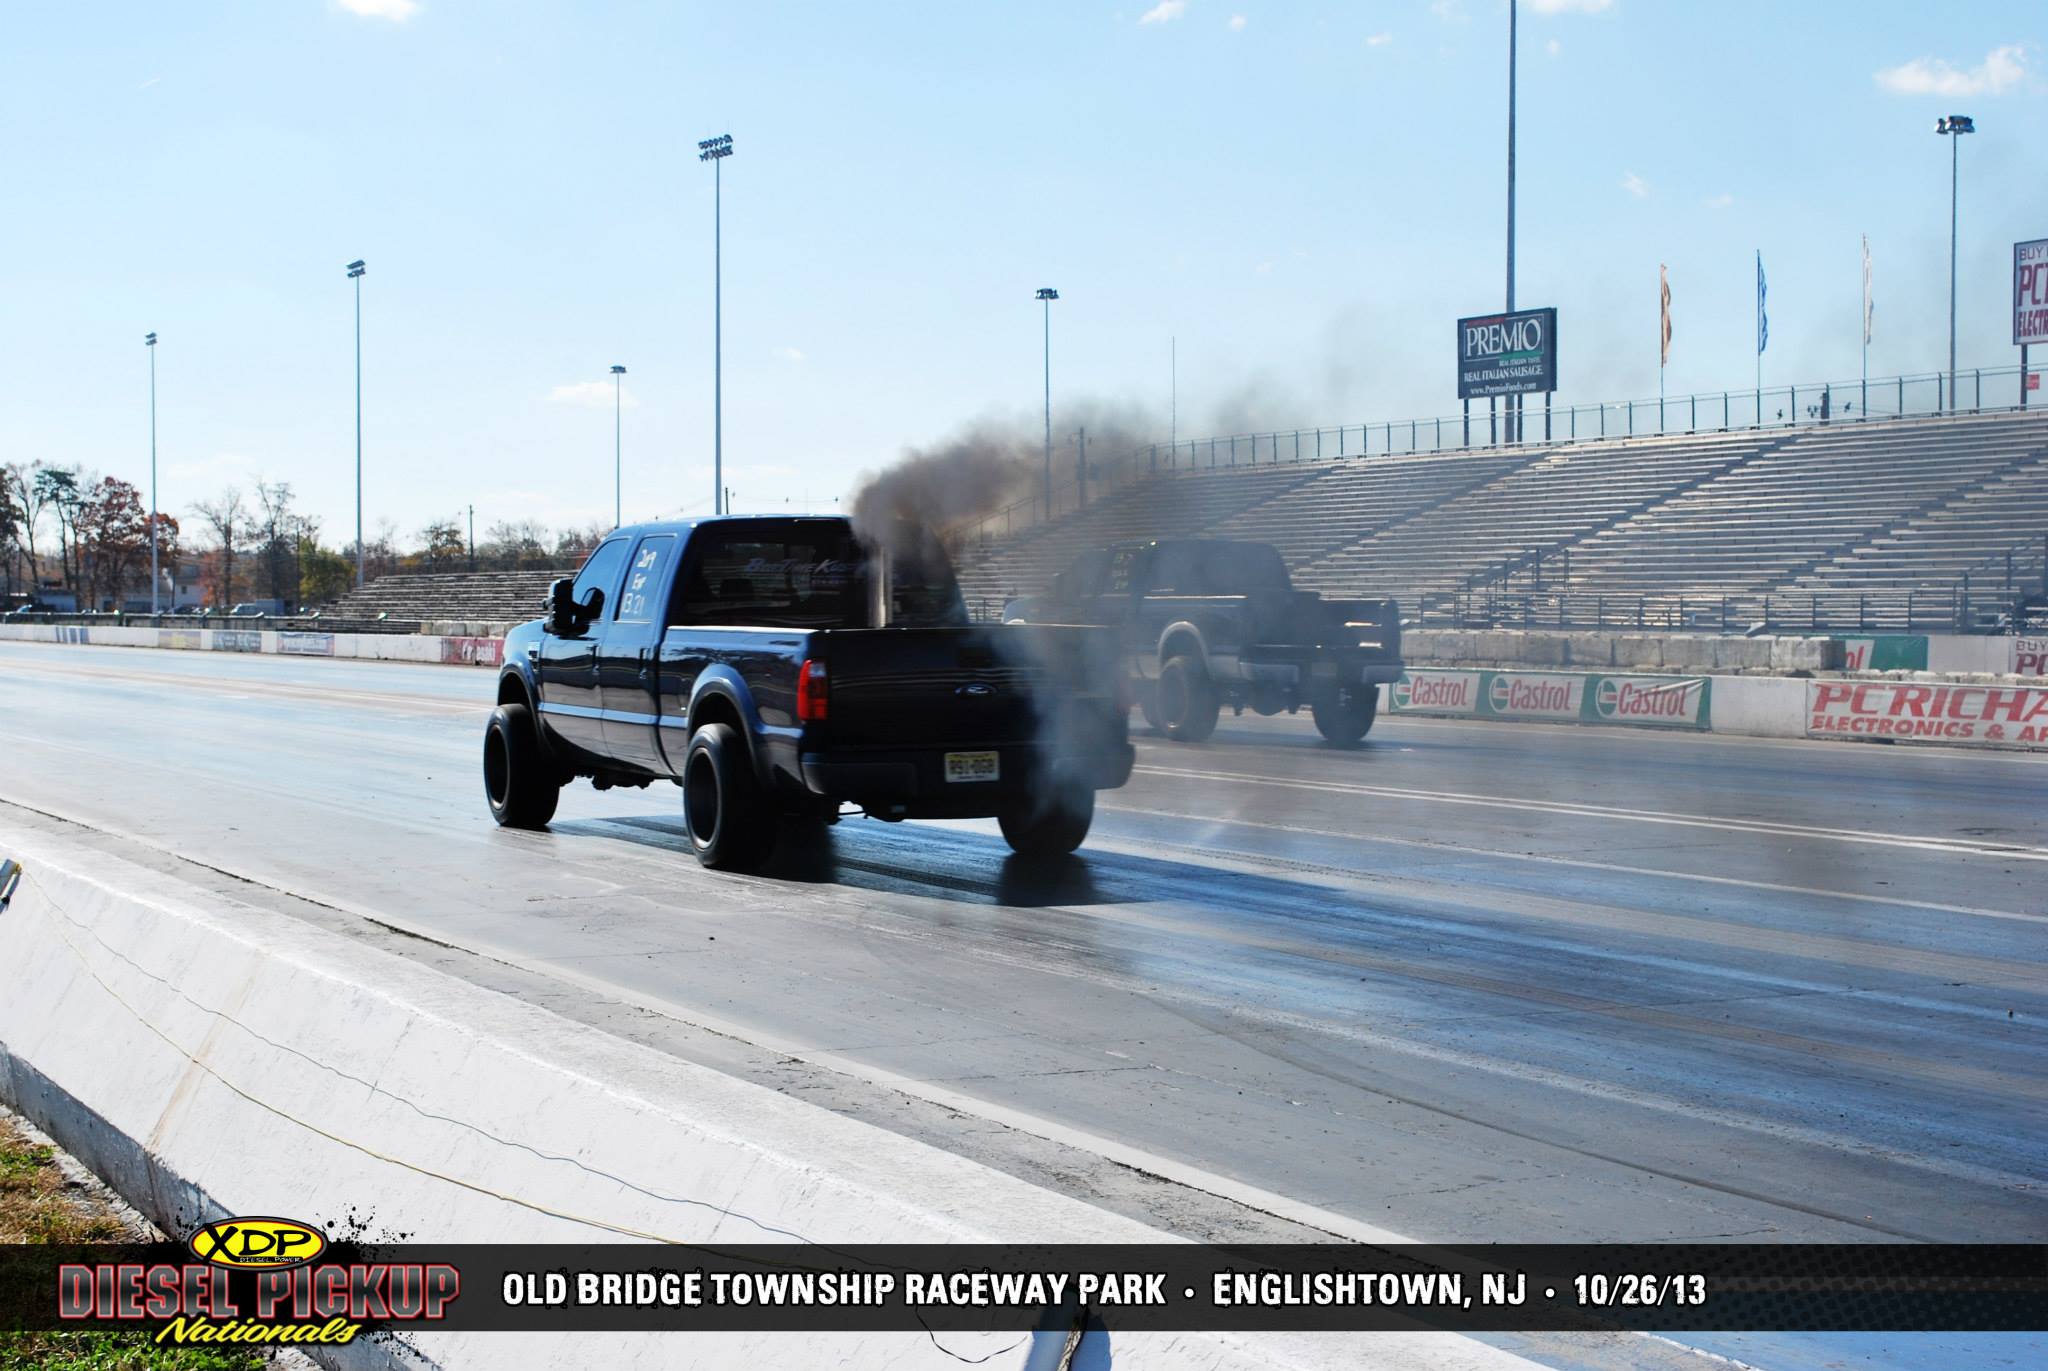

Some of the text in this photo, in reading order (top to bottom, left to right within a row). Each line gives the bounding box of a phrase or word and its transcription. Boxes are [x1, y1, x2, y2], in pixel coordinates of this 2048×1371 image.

[2019, 247, 2042, 260] BUY
[1466, 318, 1541, 357] PREMIO
[1464, 371, 1481, 382] REAL
[1482, 368, 1509, 380] ITALIAN
[1411, 675, 1469, 707] Castrol
[1509, 678, 1571, 711] Castrol
[1618, 681, 1688, 717] Castrol
[1811, 714, 1974, 738] ELECTRONICS
[1984, 723, 2004, 741] &
